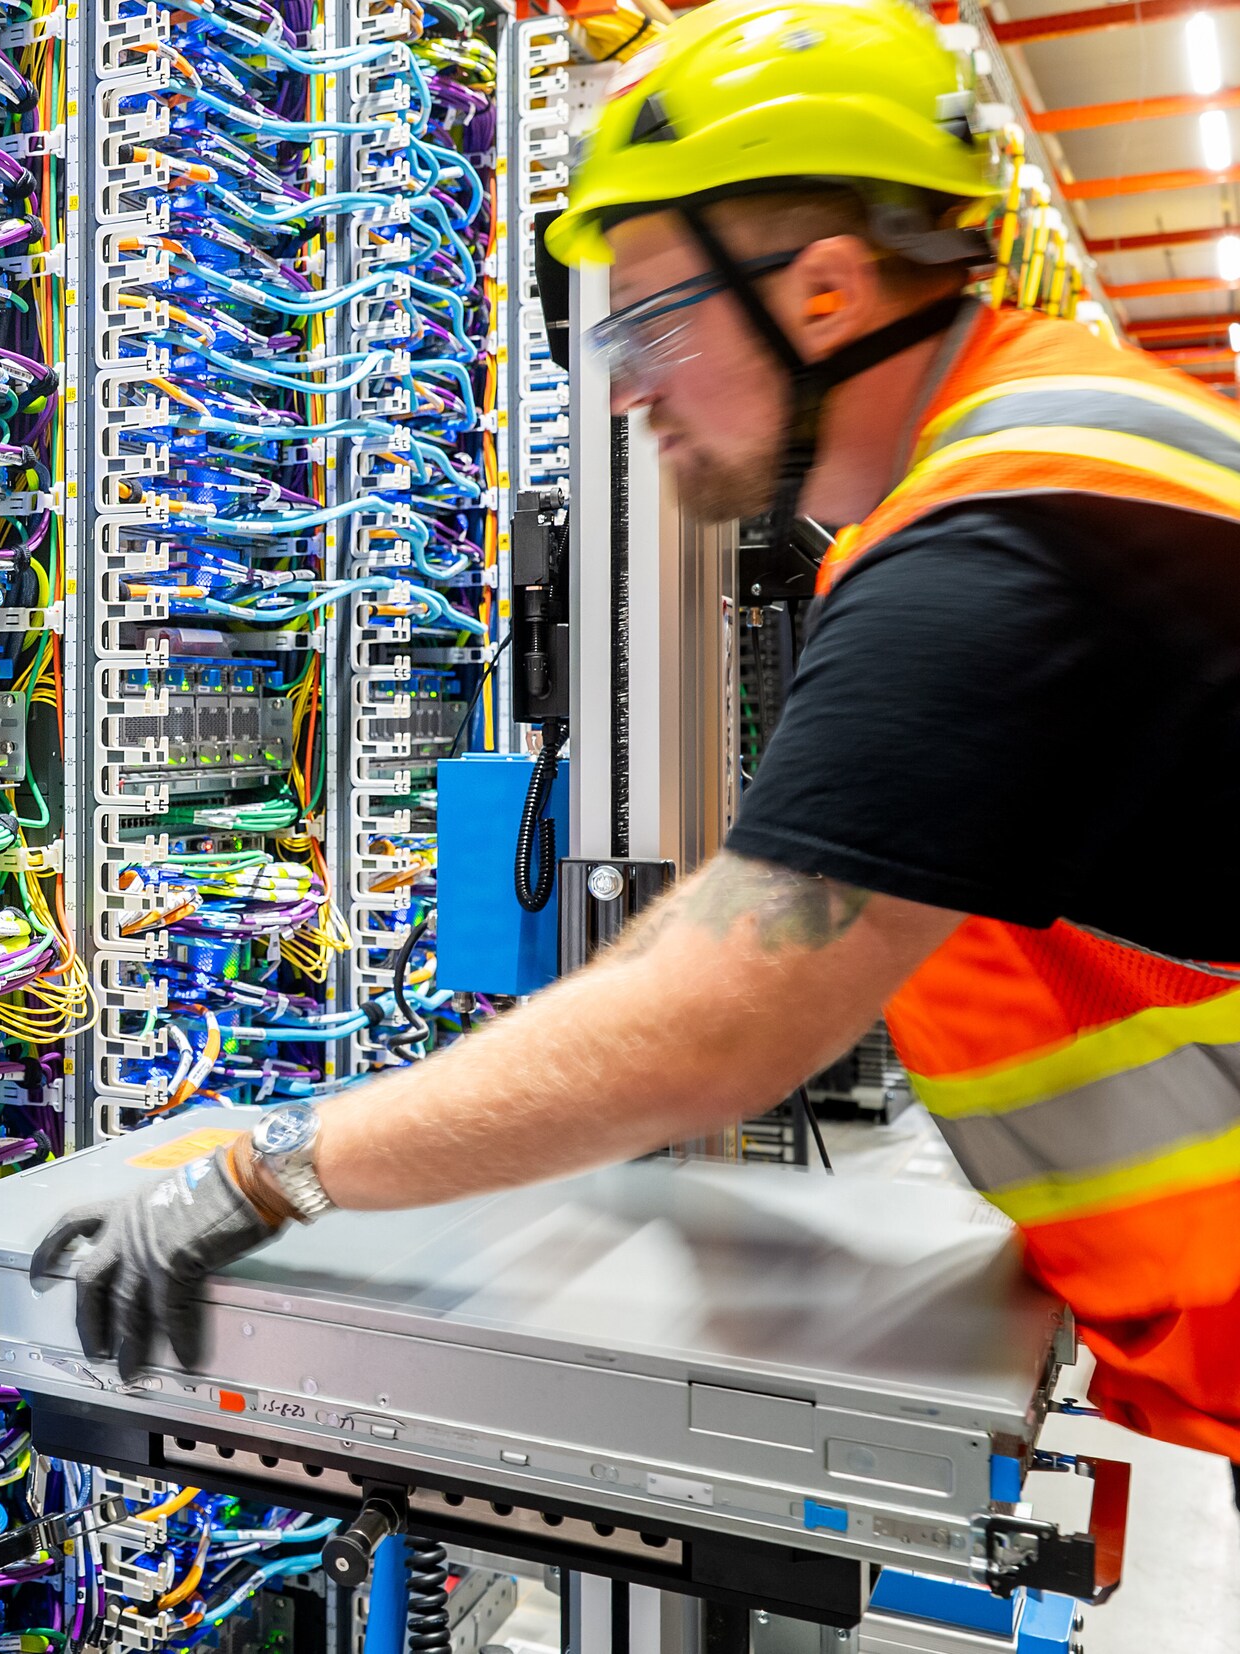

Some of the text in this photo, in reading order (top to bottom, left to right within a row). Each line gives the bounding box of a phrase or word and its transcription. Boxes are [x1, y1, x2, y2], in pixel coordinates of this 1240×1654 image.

[68, 103, 77, 113] J2
[67, 292, 75, 301] J4
[67, 390, 76, 399] J5
[68, 485, 76, 494] J6
[67, 582, 75, 591] J7
[67, 805, 74, 814] 24
[67, 853, 74, 863] 23
[65, 1062, 73, 1071] J0
